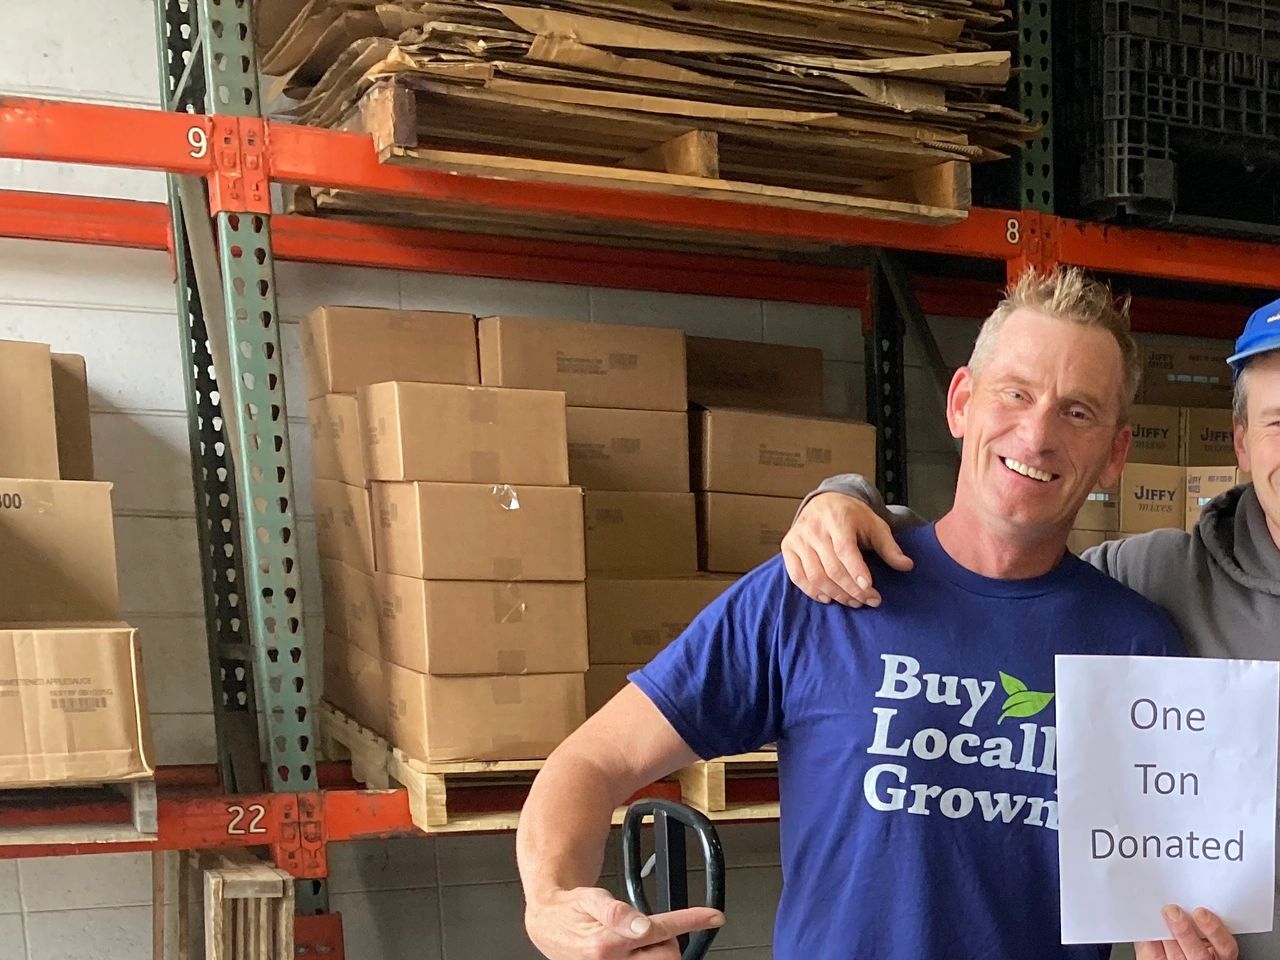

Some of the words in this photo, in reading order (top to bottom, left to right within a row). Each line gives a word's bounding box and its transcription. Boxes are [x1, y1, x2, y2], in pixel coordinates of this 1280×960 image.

[187, 127, 207, 158] 9
[1005, 218, 1020, 244] 8
[1132, 424, 1169, 439] JIFFY
[1134, 485, 1177, 502] JIFFY
[1138, 502, 1173, 513] mixes
[874, 653, 996, 727] Buy
[1130, 698, 1207, 731] One
[866, 706, 1057, 776] Locall
[1134, 763, 1199, 796] Ton
[227, 804, 267, 835] 22
[1090, 828, 1245, 862] Donated
